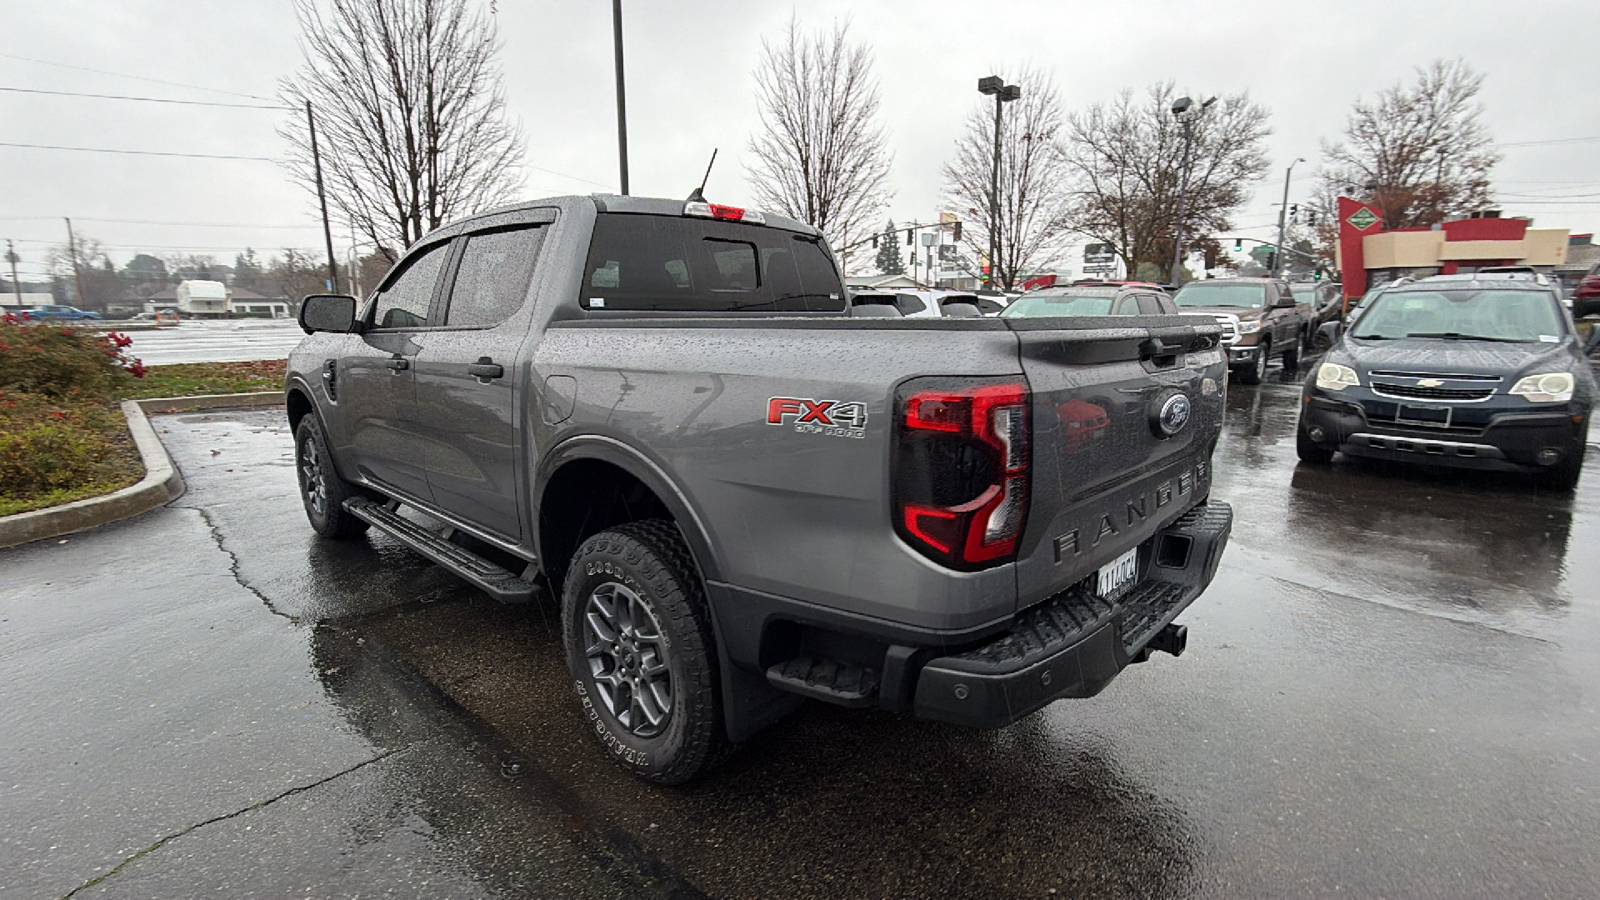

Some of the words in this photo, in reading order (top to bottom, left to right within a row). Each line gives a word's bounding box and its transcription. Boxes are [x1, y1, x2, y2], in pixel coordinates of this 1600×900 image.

[766, 396, 868, 429] FX4
[795, 424, 823, 434] OFF
[825, 427, 866, 438] ROAD
[1053, 461, 1208, 566] RANGER
